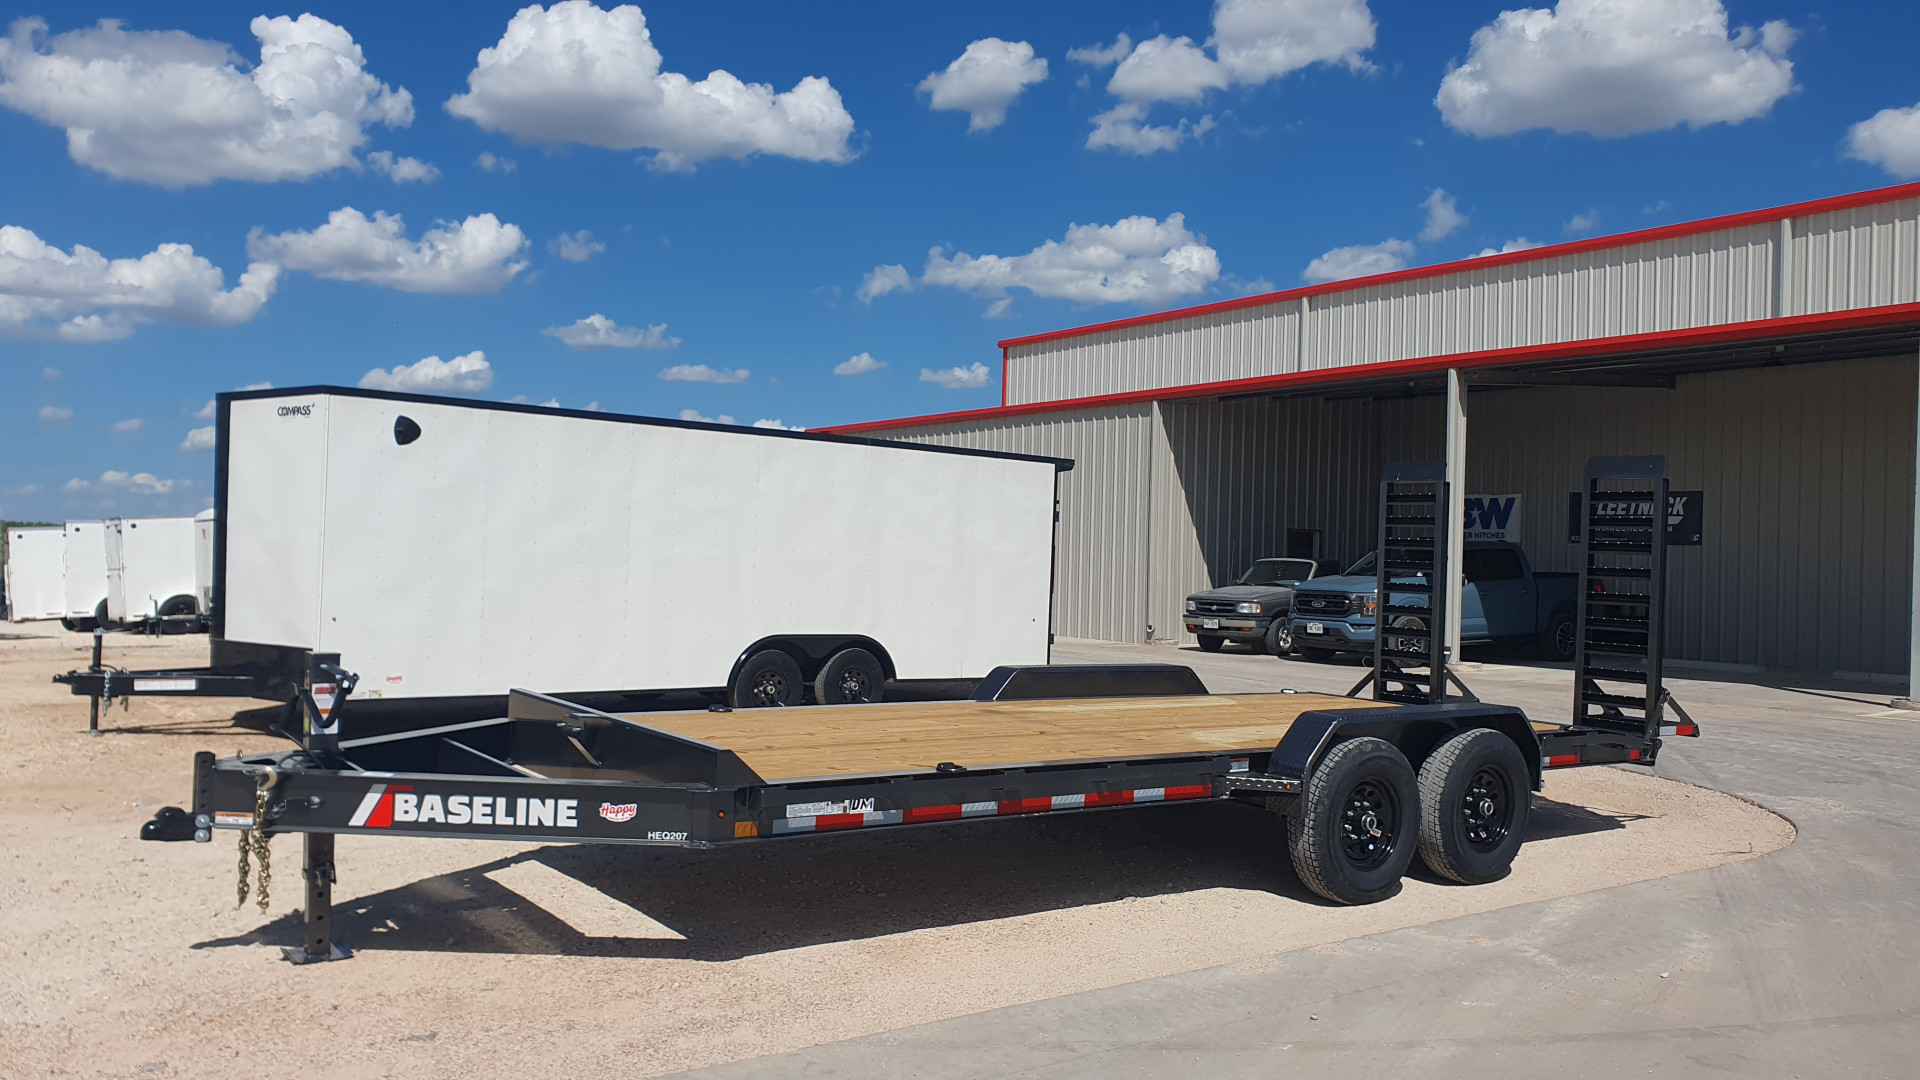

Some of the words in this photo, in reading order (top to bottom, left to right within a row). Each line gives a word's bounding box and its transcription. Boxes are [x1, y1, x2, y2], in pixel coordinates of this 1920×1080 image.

[277, 405, 311, 416] COMPASS
[393, 793, 579, 828] BASELINE
[600, 803, 637, 818] Happy
[647, 831, 688, 841] HEQ207
